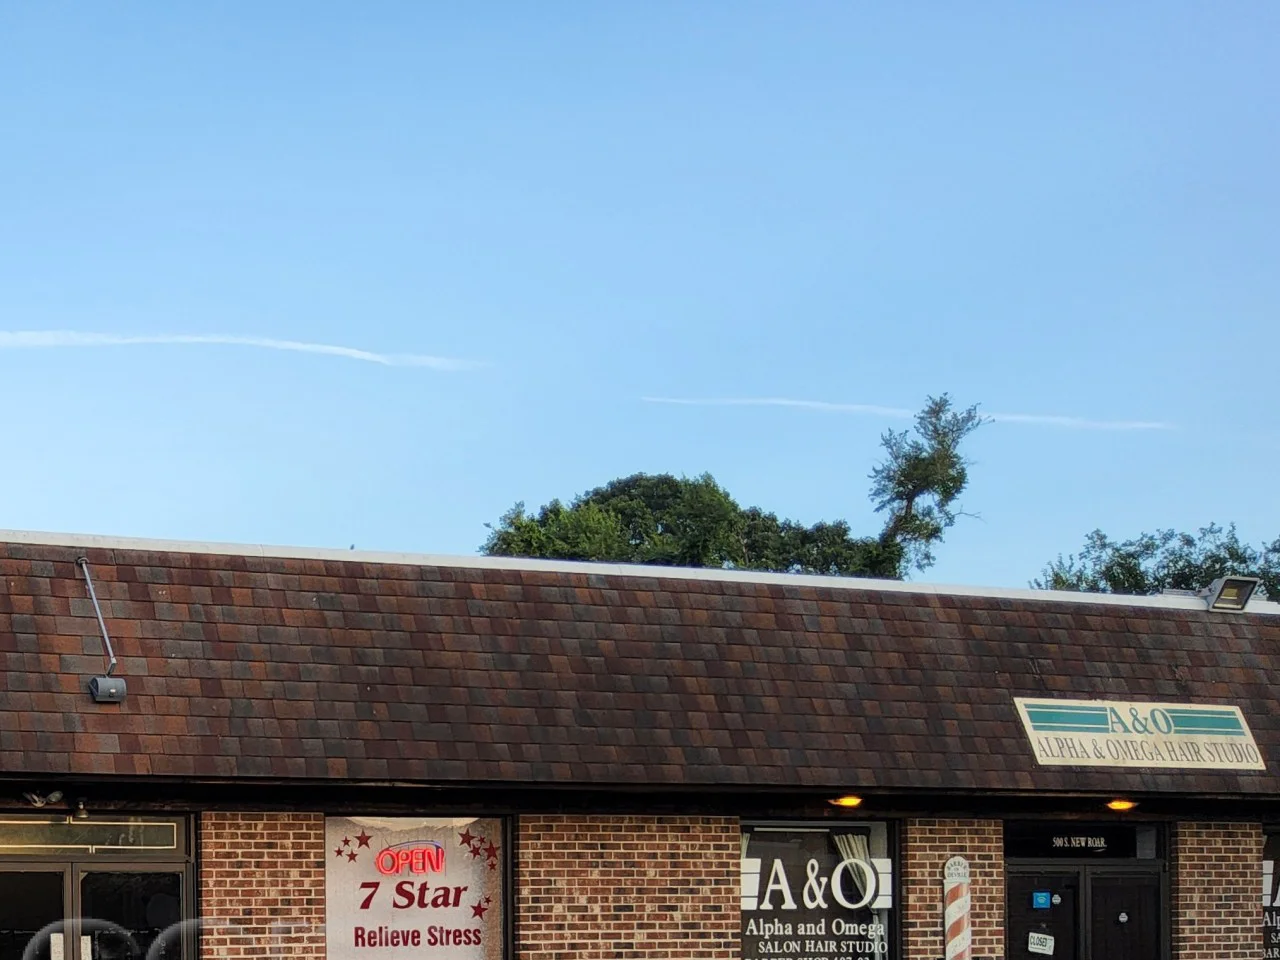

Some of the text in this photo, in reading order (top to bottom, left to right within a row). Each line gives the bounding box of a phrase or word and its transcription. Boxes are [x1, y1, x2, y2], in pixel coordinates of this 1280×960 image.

[1107, 706, 1174, 735] A&O
[1036, 736, 1259, 764] ALPHA & OMEGA HAIR STUDIO
[1070, 836, 1087, 848] NEW
[375, 846, 445, 875] OPEN
[359, 881, 468, 910] 7 Star
[760, 858, 876, 910] A&O
[354, 925, 482, 947] Relieve Stress
[745, 918, 884, 938] Alpha and Omega
[758, 940, 888, 954] SALON HAIR STUDIO
